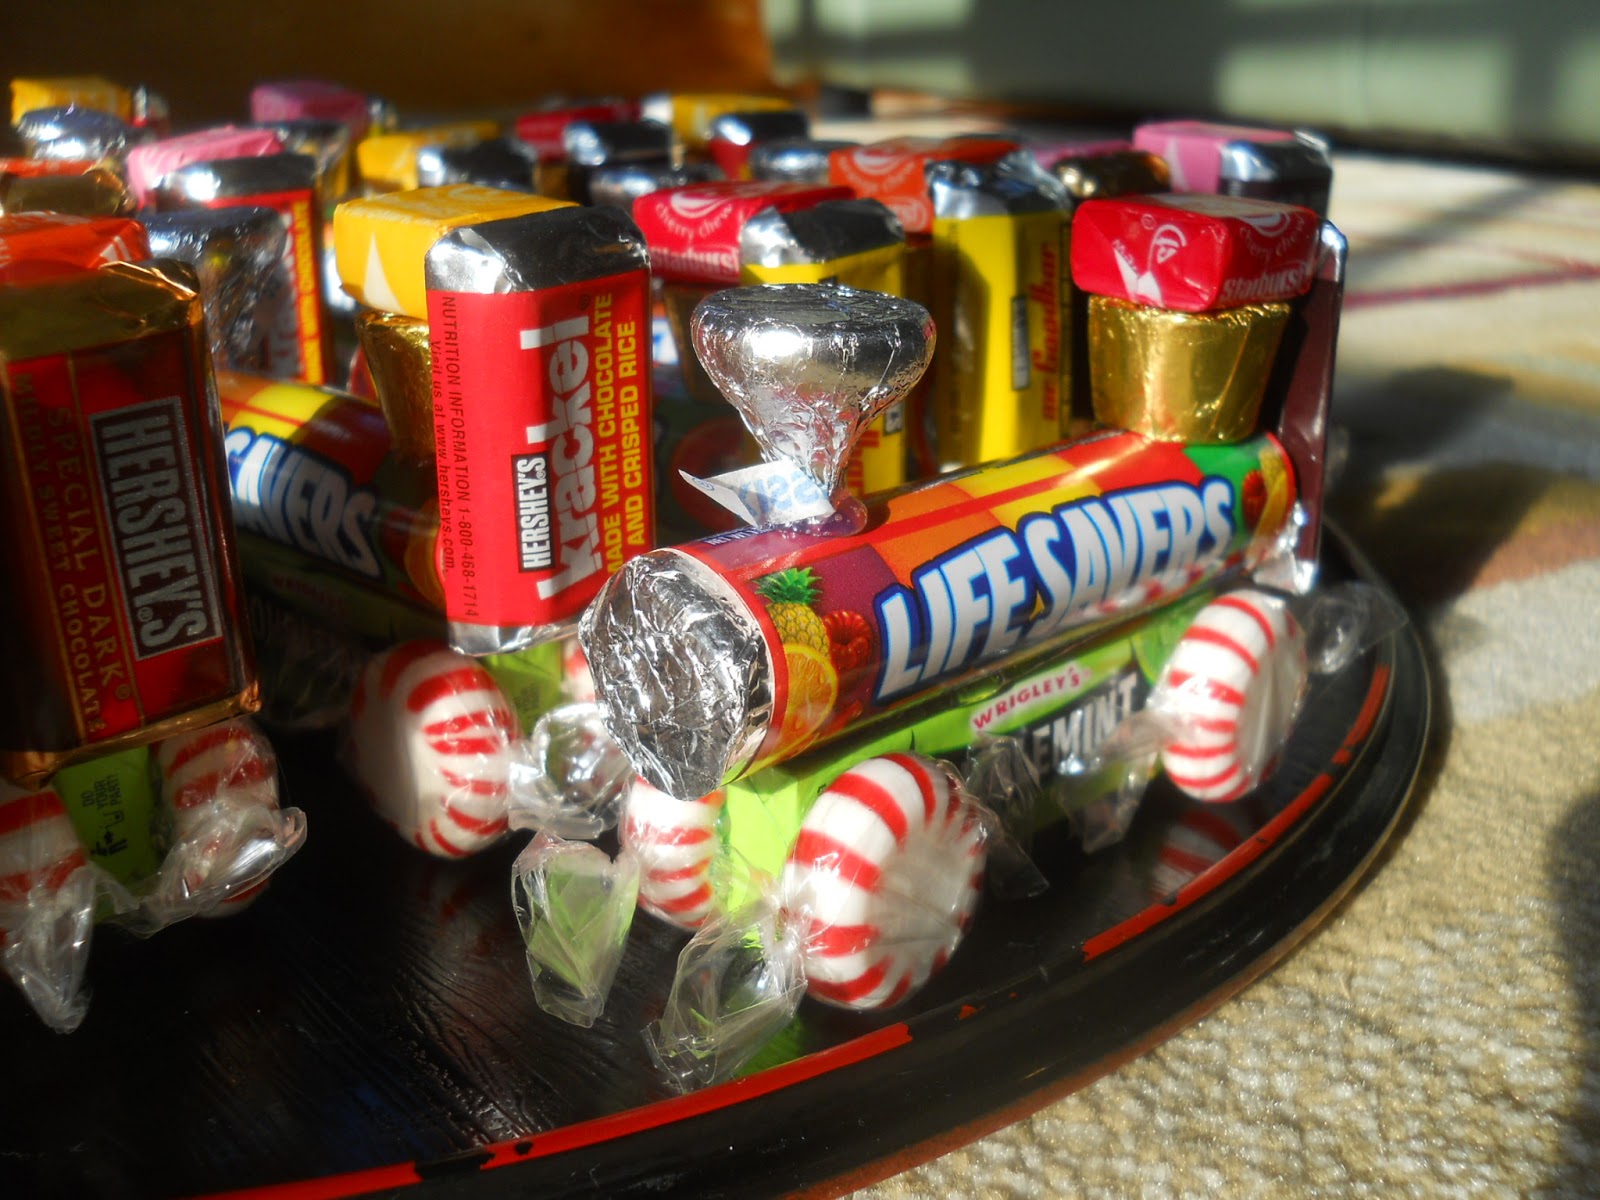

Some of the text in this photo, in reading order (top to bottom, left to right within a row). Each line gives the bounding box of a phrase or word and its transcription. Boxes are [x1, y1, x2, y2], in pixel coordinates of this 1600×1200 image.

[699, 203, 735, 238] chew
[431, 341, 443, 374] Visit
[433, 381, 443, 398] us
[434, 404, 446, 418] at
[594, 293, 616, 438] CHOCOLATE
[442, 296, 479, 616] NUTRITION INFORMATION 1-800-468-1714
[520, 316, 603, 600] krackel
[600, 444, 620, 509] WITH
[617, 321, 645, 545] AND CRISPED RICE
[38, 483, 71, 571] SWEET
[48, 407, 126, 688] SPECIAL DARK
[102, 414, 208, 650] HERSHEY'S
[517, 457, 552, 569] HERSHEY'S
[877, 479, 1234, 700] LIFE SAVERS
[973, 666, 1080, 730] WRIGLEY'S
